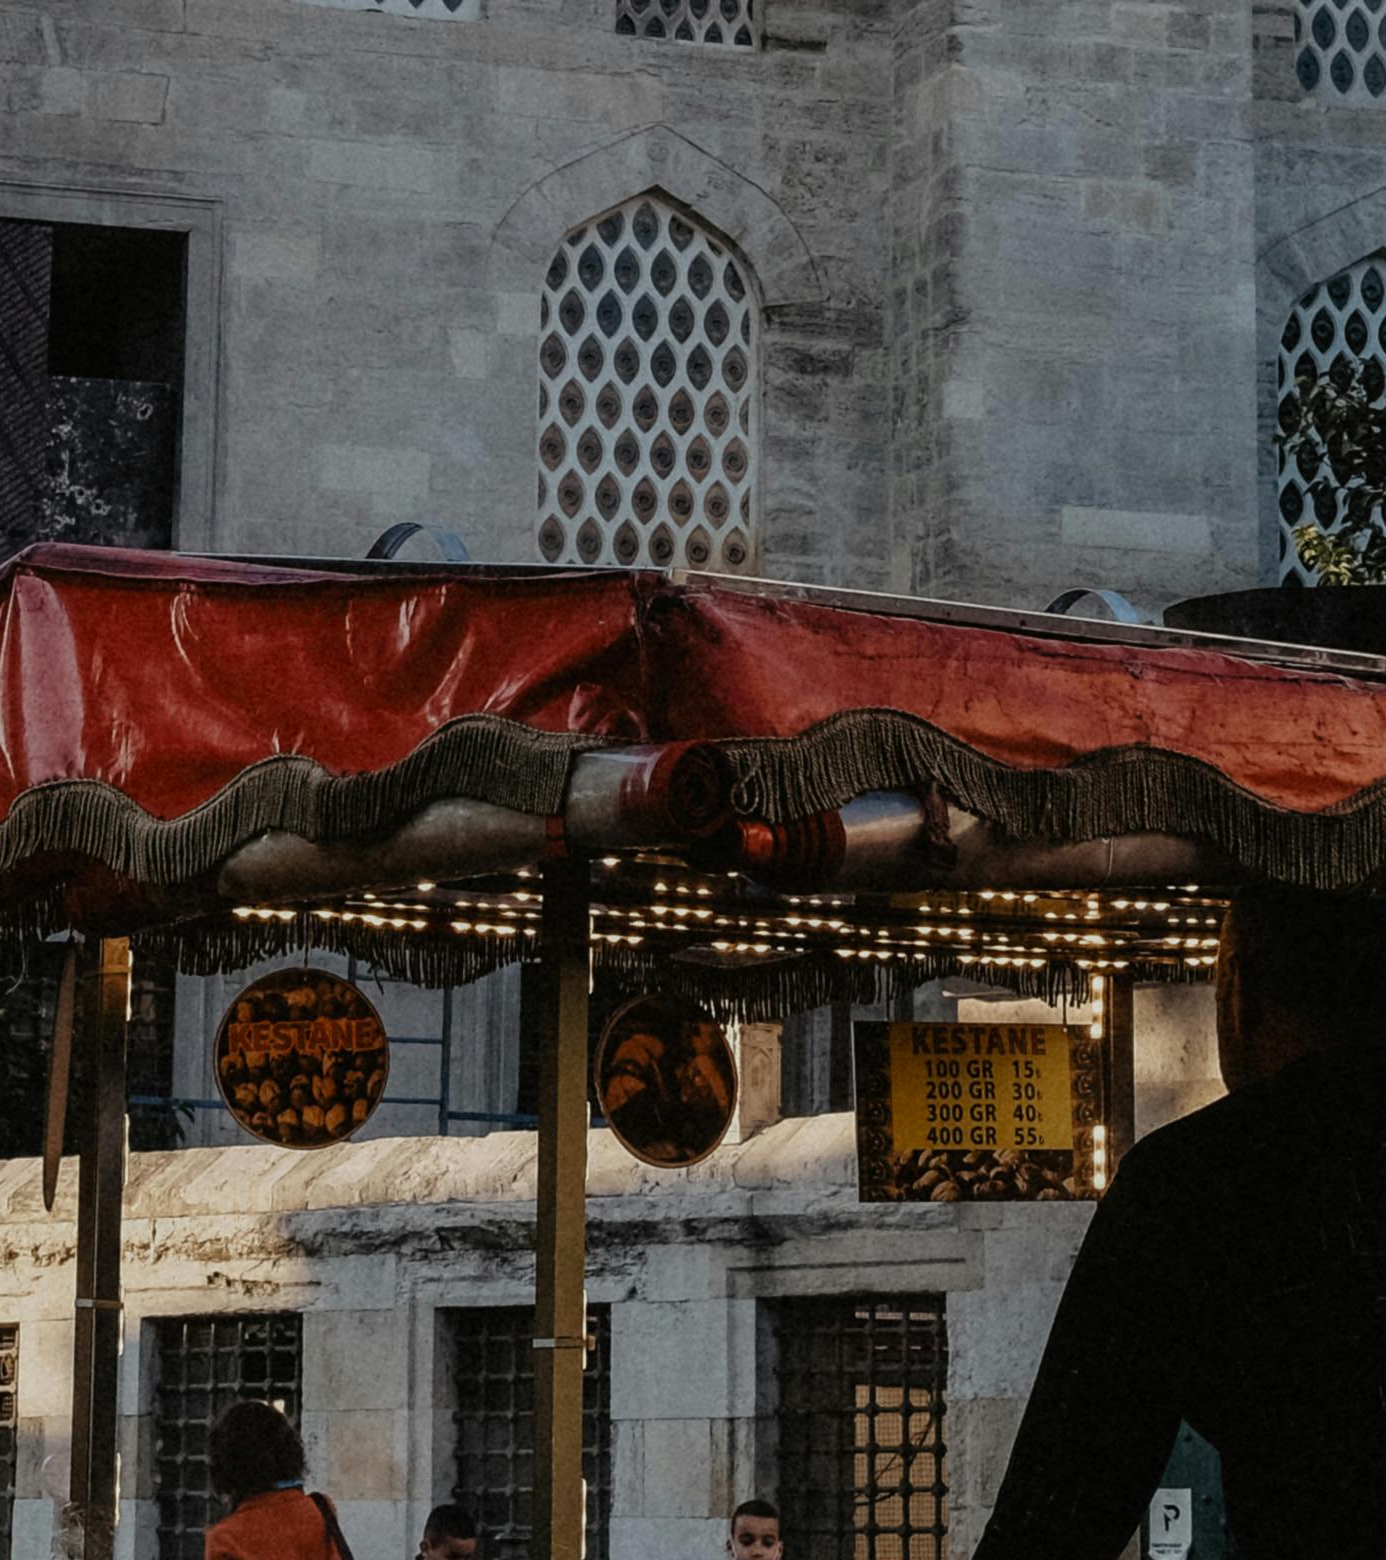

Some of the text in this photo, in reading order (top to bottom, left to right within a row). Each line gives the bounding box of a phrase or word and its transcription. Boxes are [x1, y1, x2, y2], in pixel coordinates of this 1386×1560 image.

[229, 1020, 377, 1052] KESTANE
[912, 1026, 1047, 1056] KESTANE
[925, 1060, 960, 1079] 100
[967, 1060, 993, 1079] GR
[926, 1081, 962, 1100] 200
[969, 1081, 996, 1100] GR
[927, 1104, 963, 1123] 300
[970, 1104, 997, 1123] GR
[927, 1127, 963, 1145] 400
[970, 1127, 997, 1145] GR
